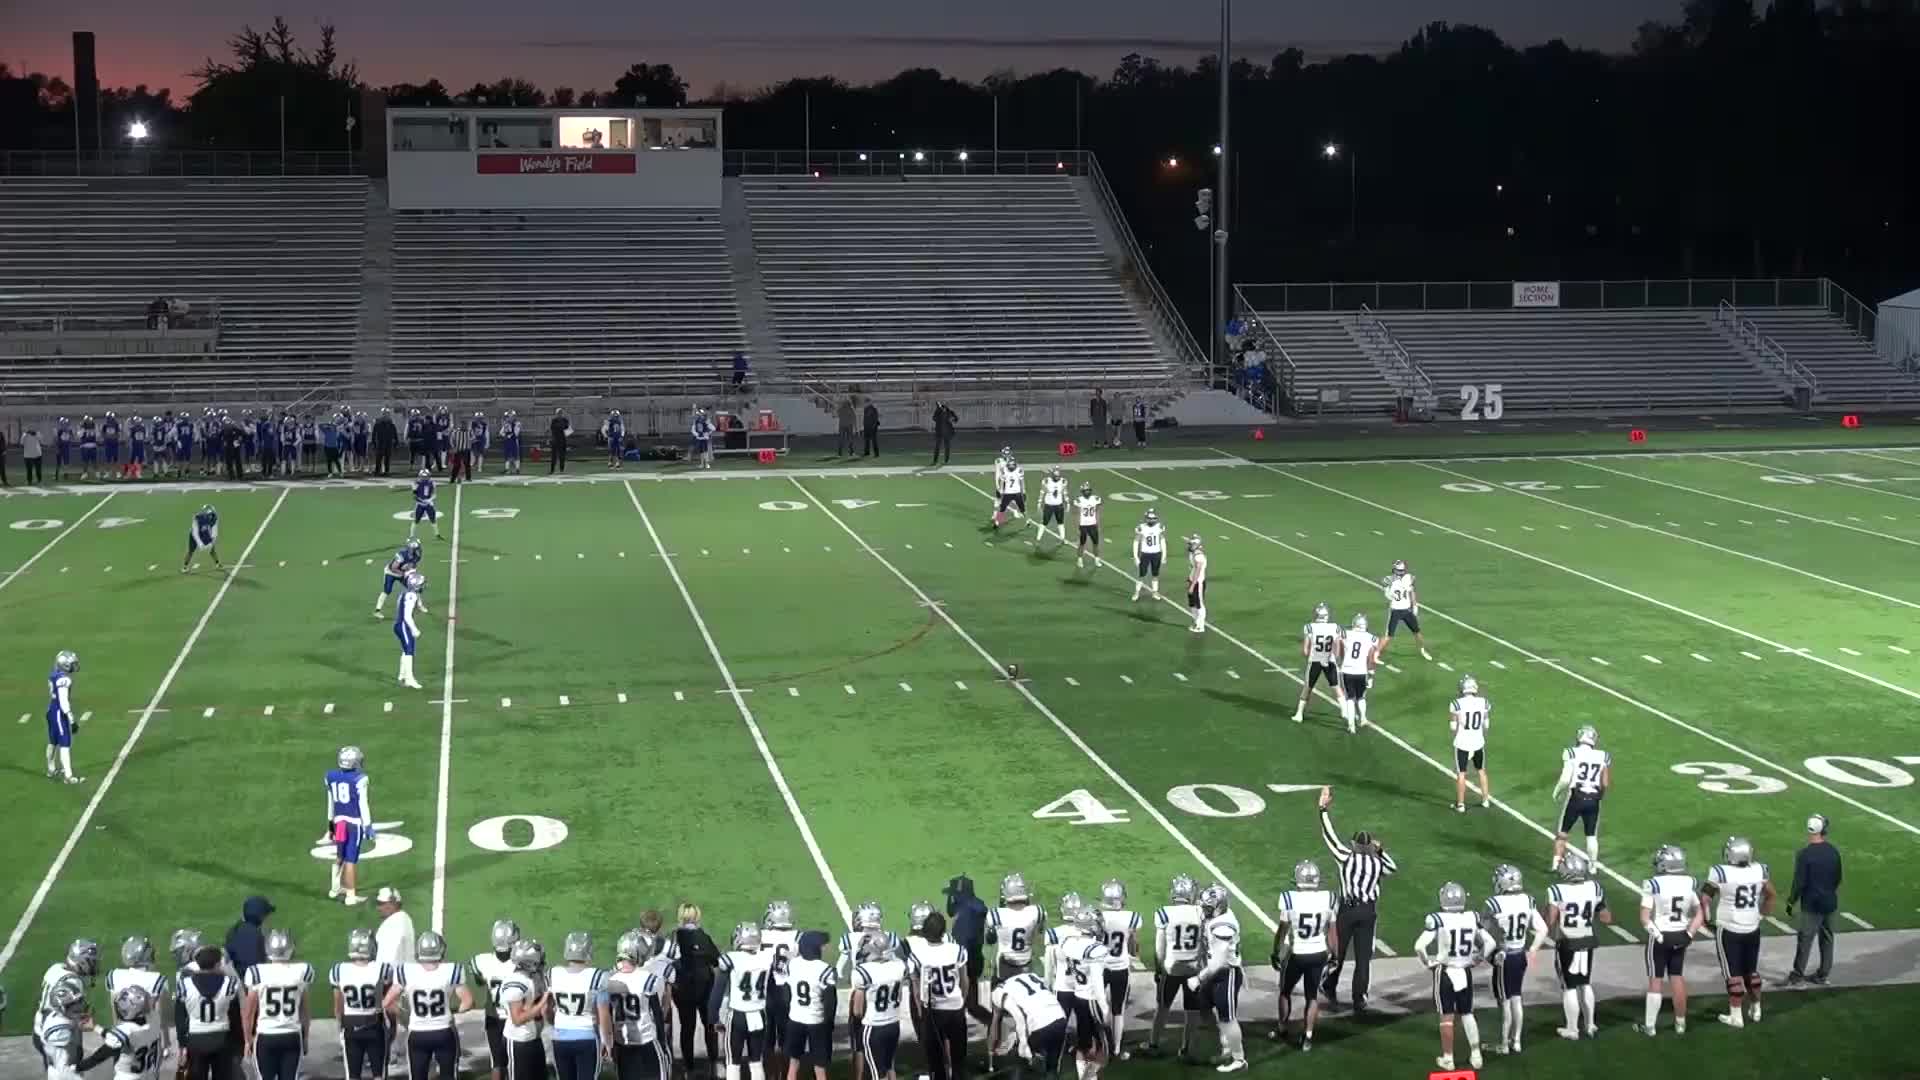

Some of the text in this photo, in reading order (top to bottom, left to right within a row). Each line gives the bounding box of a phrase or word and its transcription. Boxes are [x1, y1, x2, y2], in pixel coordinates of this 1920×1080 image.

[564, 155, 592, 172] Field
[1460, 384, 1503, 420] 25
[1146, 535, 1157, 547] 81
[1315, 635, 1333, 653] 52
[1352, 641, 1362, 659] 8
[1464, 711, 1482, 730] 10
[1577, 762, 1601, 782] 37
[330, 781, 350, 803] 18
[1670, 896, 1684, 922] 5
[1735, 883, 1757, 909] 61
[1298, 913, 1321, 939] 51
[1507, 912, 1527, 941] 16
[1564, 901, 1593, 928] 24
[1012, 928, 1025, 951] 6
[1172, 924, 1199, 950] 13
[1449, 928, 1473, 957] 15
[343, 984, 376, 1008] 26
[739, 970, 767, 1001] 44
[796, 981, 811, 1007] 9
[200, 1000, 215, 1023] 0
[265, 986, 298, 1016] 55
[413, 989, 446, 1017] 62
[555, 992, 586, 1016] 57
